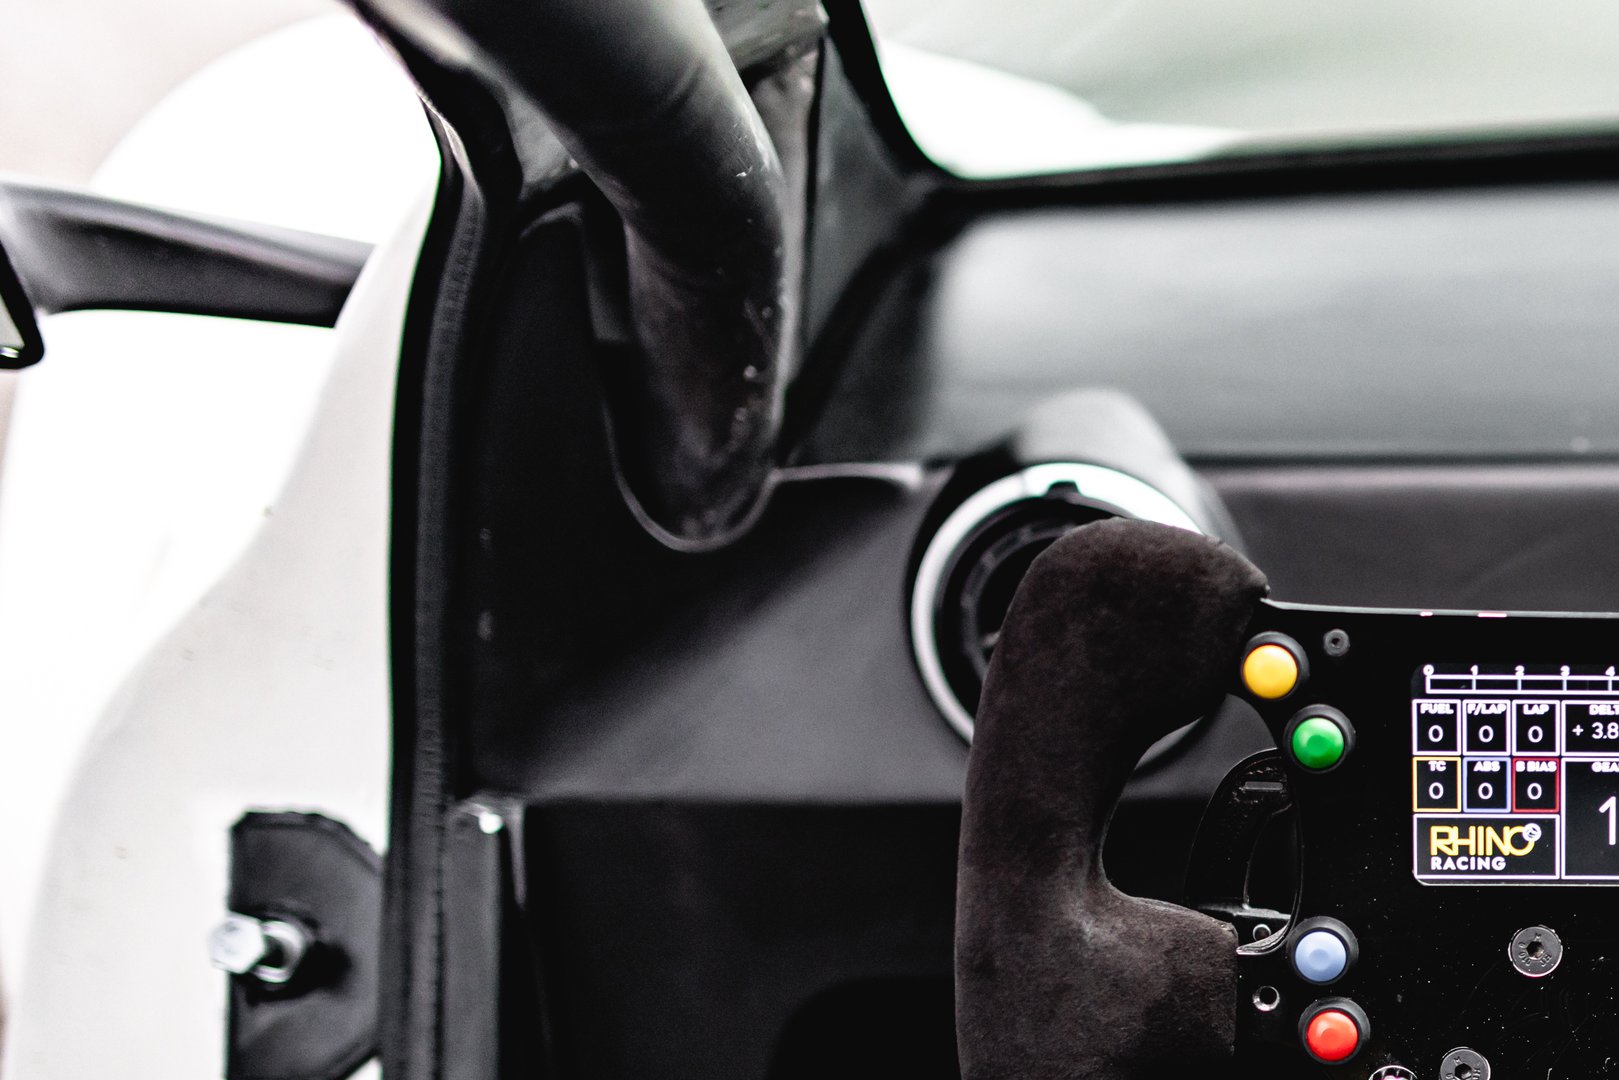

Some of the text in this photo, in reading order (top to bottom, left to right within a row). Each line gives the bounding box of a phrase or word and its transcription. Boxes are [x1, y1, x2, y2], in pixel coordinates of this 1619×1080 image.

[1423, 664, 1435, 676] 0
[1471, 665, 1478, 675] 1
[1514, 665, 1525, 676] 2
[1560, 665, 1571, 676] 3
[1605, 666, 1615, 676] 4
[1420, 703, 1454, 714] FUEL
[1467, 704, 1506, 715] F/LAP
[1523, 704, 1549, 715] LAP
[1429, 725, 1443, 742] 0
[1479, 725, 1493, 742] 0
[1528, 726, 1543, 742] 0
[1427, 760, 1447, 771] TC
[1429, 782, 1443, 799] 0
[1478, 783, 1493, 799] 0
[1527, 783, 1542, 799] 0
[1599, 796, 1616, 845] 1
[1430, 826, 1535, 856] RHINO
[1430, 857, 1506, 870] RACING
